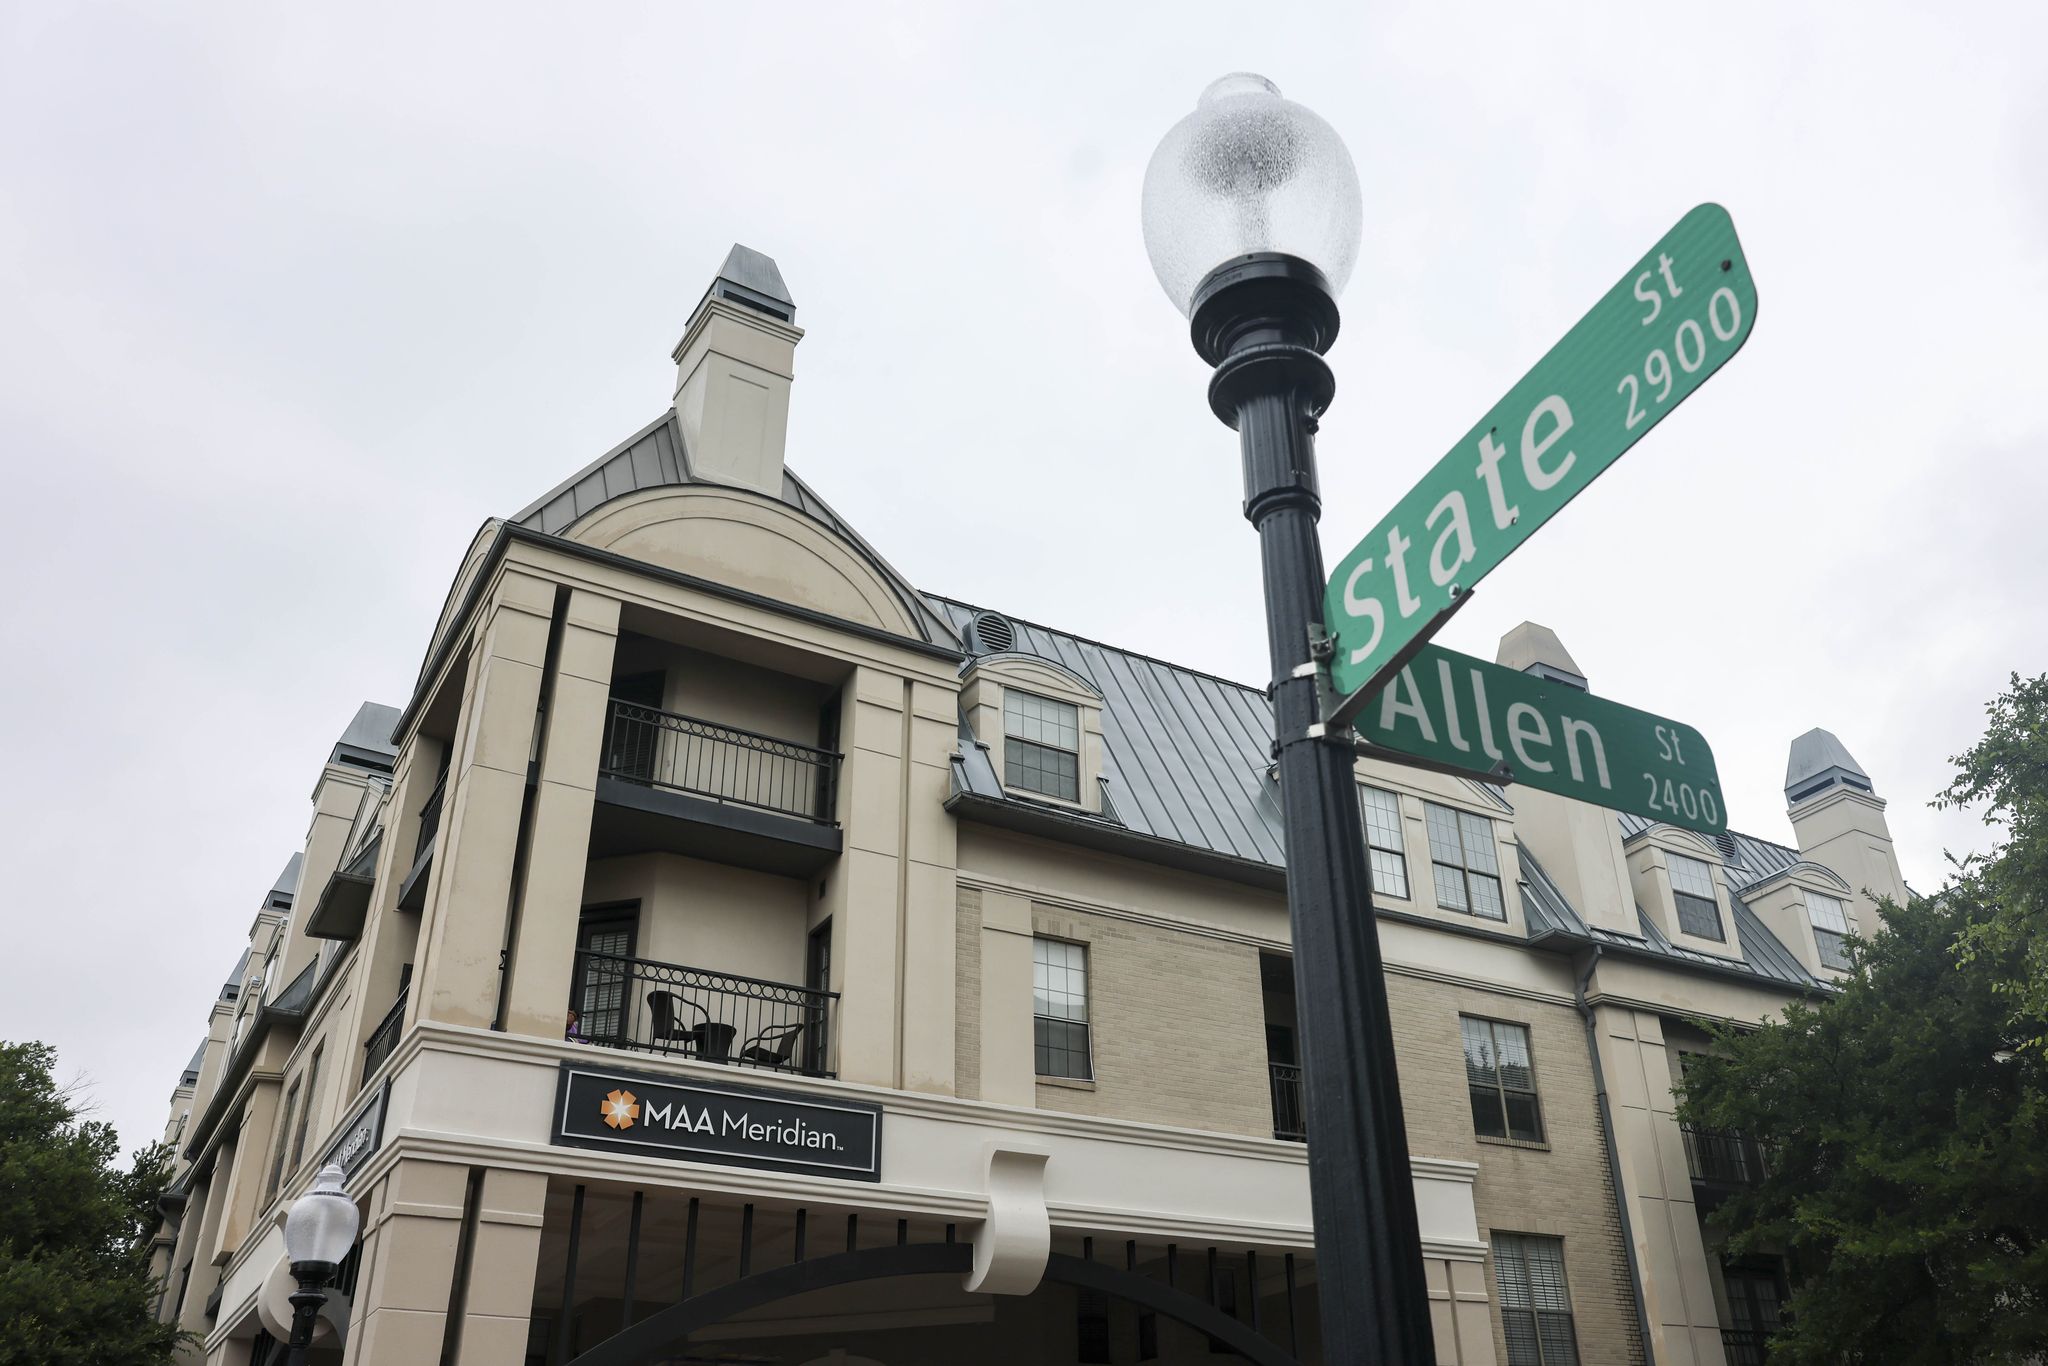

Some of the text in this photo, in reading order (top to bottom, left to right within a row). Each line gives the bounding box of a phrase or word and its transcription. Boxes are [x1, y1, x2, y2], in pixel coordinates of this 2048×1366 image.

[1617, 287, 1742, 430] 2900
[1343, 252, 1683, 665] State St
[1379, 658, 1685, 790] Allen St
[1643, 773, 1717, 825] 2400
[644, 1099, 715, 1135] MAA
[721, 1109, 836, 1150] Meridian
